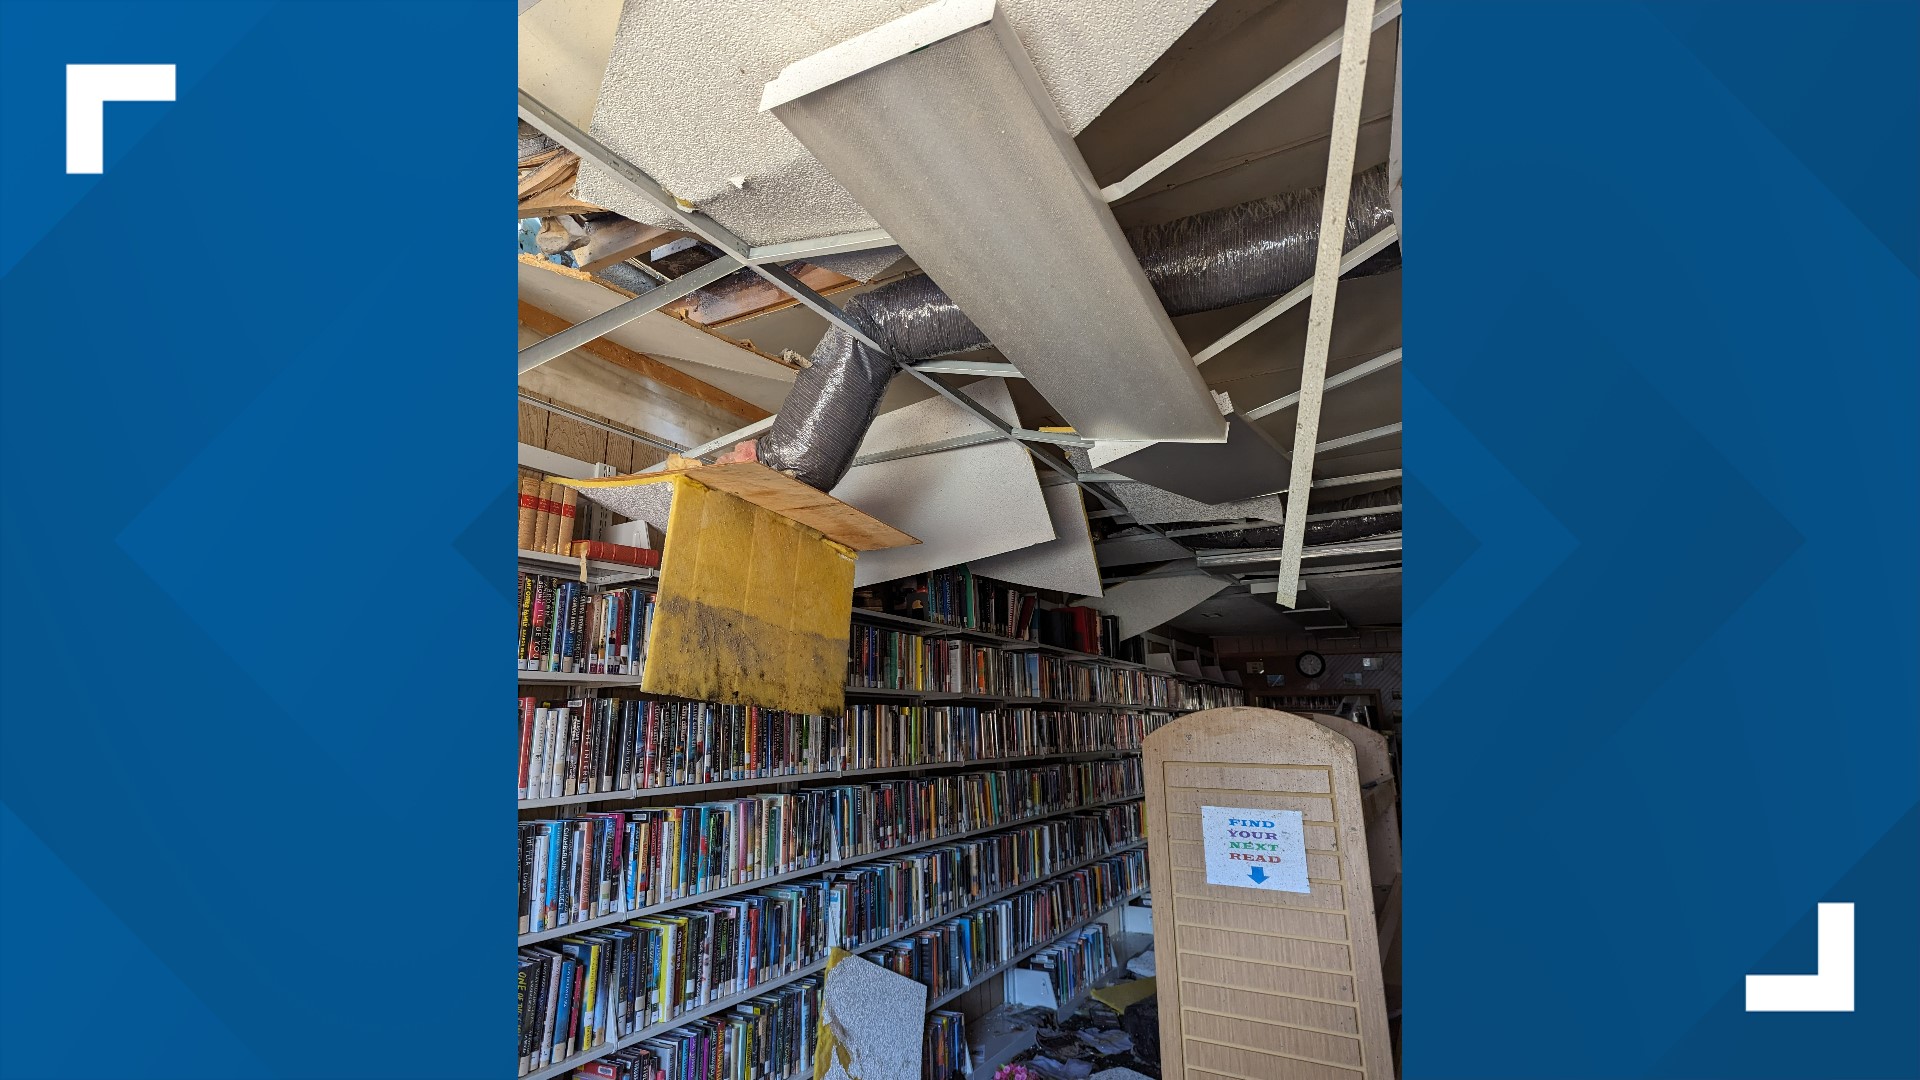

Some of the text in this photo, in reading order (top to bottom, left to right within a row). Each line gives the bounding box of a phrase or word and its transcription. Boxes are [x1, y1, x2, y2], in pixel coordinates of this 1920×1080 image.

[522, 610, 530, 627] FAMILY
[532, 641, 540, 660] YOU
[582, 749, 590, 783] INTERN
[1228, 819, 1275, 829] FIND
[1227, 829, 1279, 840] YOUR
[561, 827, 570, 870] CHAMBERLAIN
[1229, 841, 1279, 852] NEXT
[1229, 853, 1281, 864] READ
[519, 972, 527, 991] ONE
